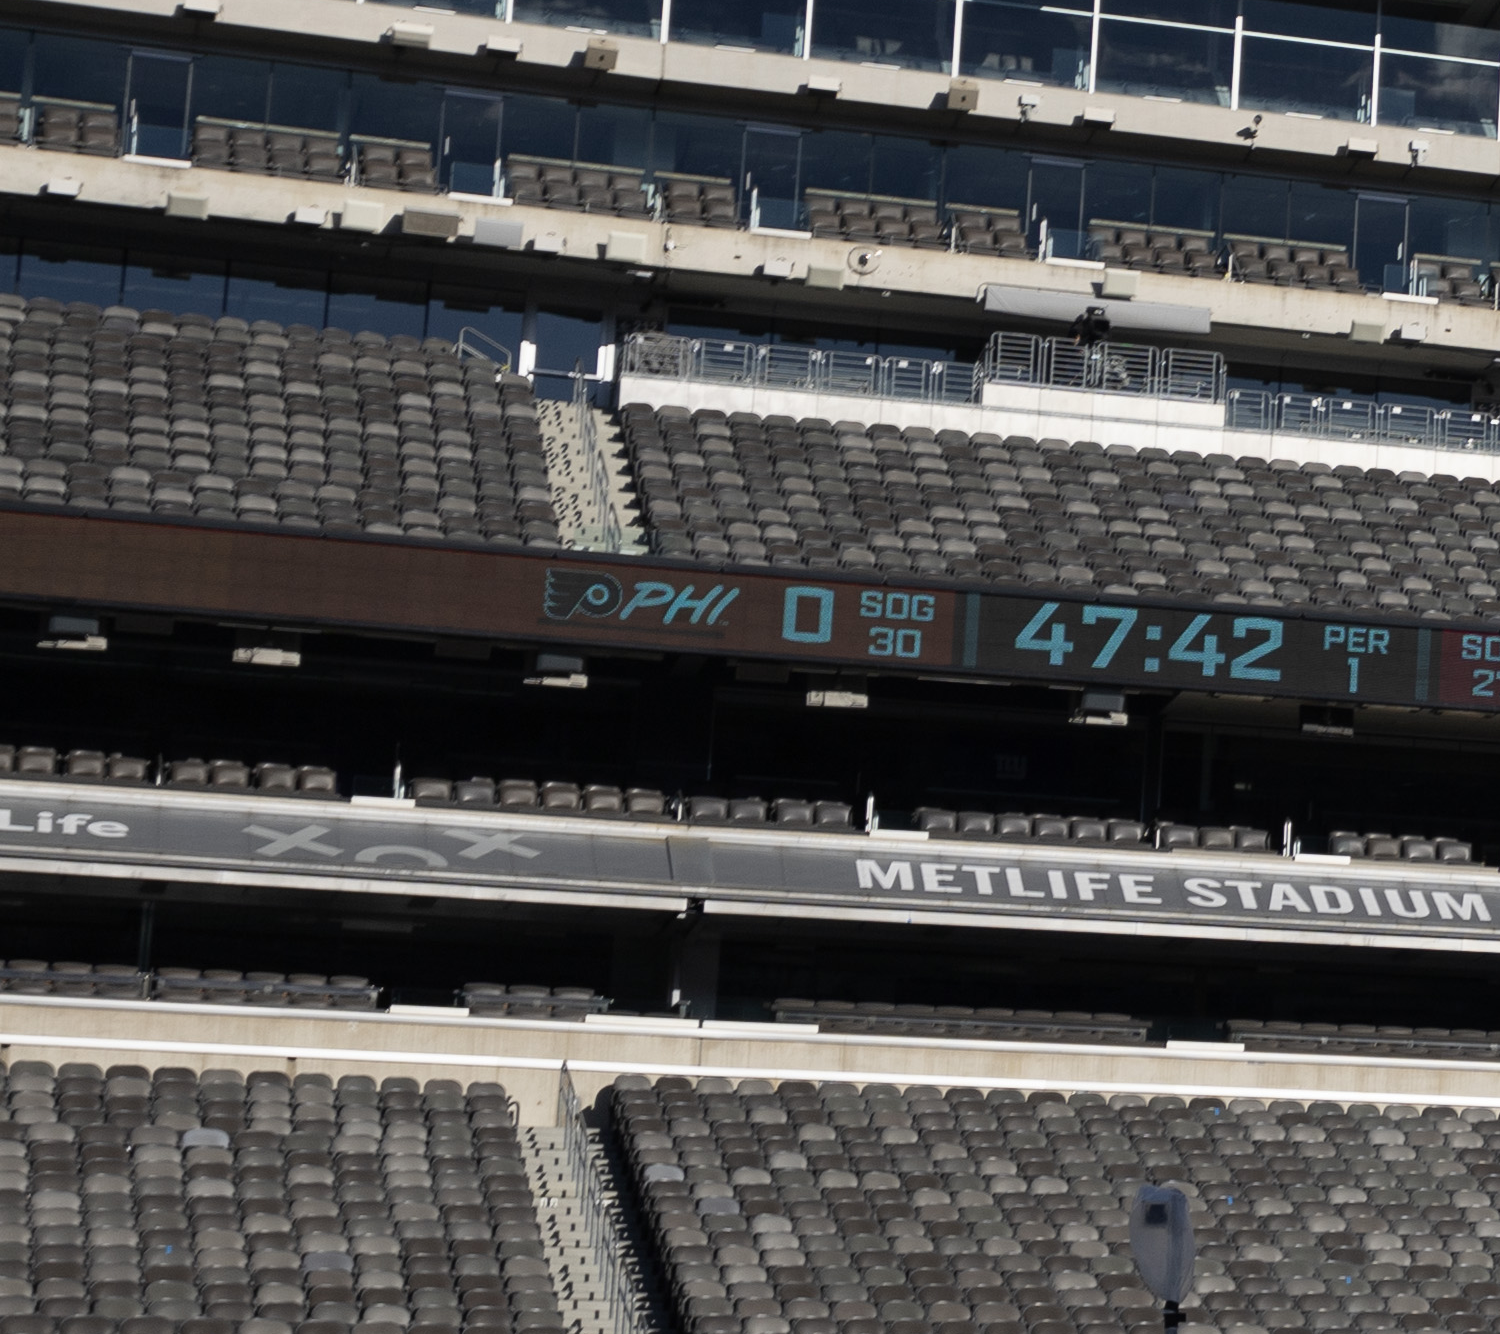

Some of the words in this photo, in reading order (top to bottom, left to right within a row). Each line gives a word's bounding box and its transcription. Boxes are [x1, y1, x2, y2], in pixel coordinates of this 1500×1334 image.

[619, 581, 741, 626] PHI
[782, 586, 835, 644] 0
[860, 590, 936, 624] SOG
[868, 626, 922, 659] 30
[1014, 601, 1284, 682] 47:42
[1323, 624, 1391, 655] PER
[1347, 657, 1359, 694] 1
[856, 858, 1163, 907] METLIFE
[1183, 876, 1494, 923] STADIUM
